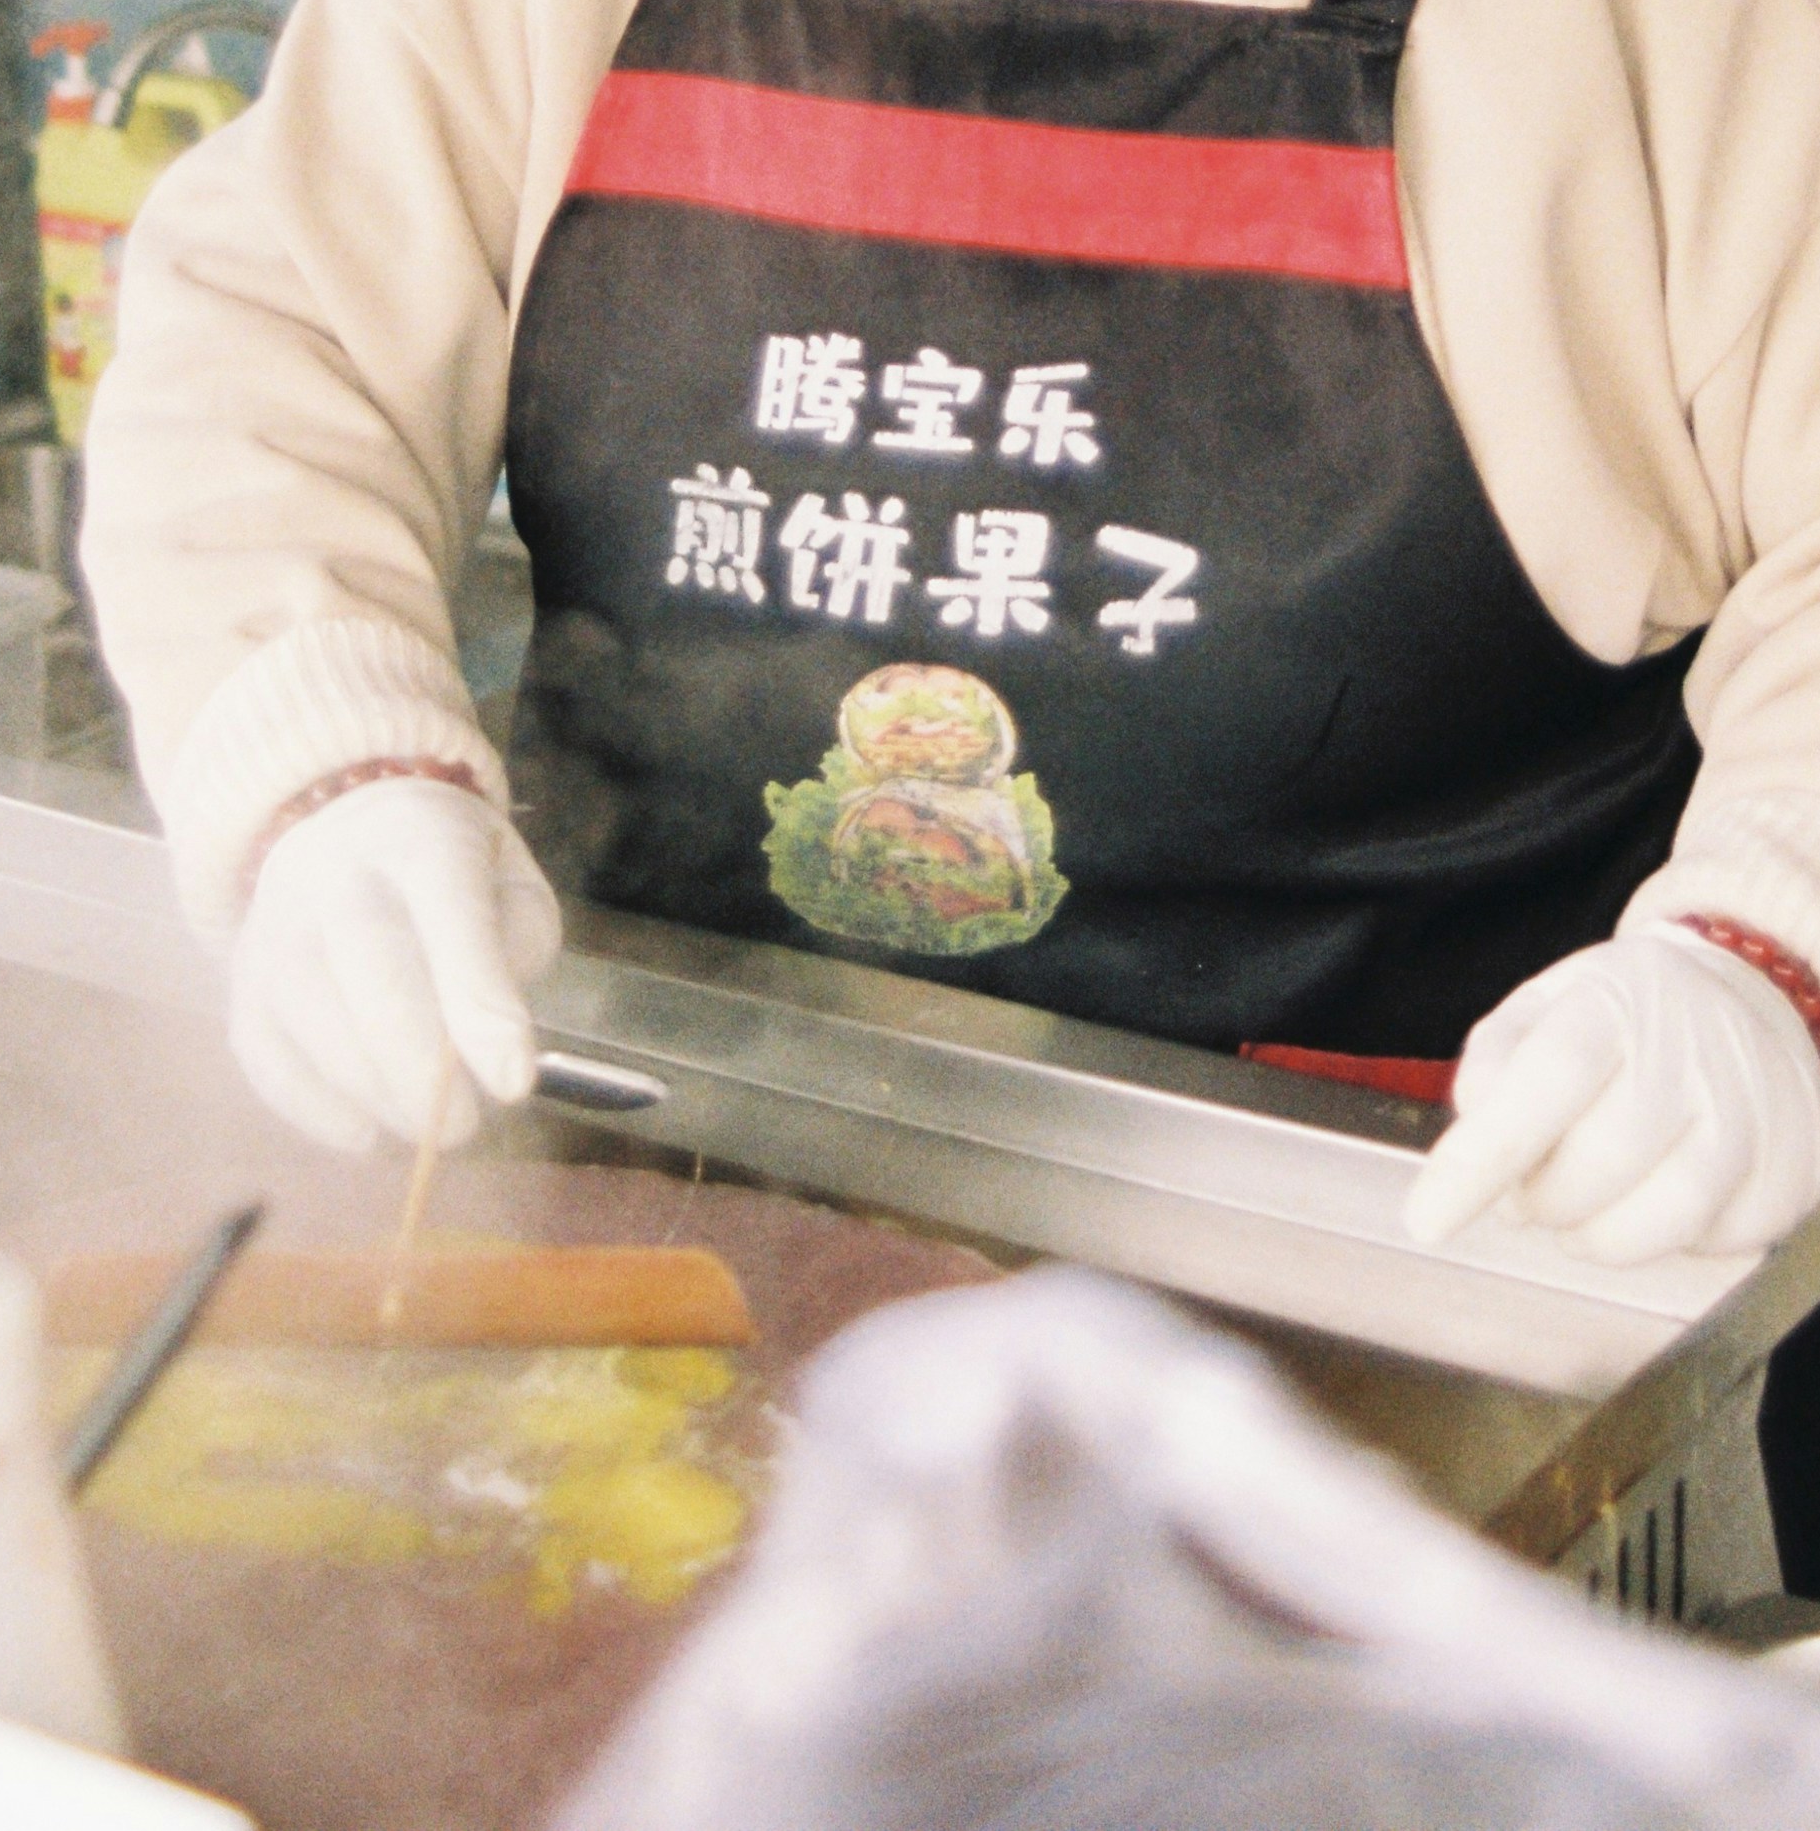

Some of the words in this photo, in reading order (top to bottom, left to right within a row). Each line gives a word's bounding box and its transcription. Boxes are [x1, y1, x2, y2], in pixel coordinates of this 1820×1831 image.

[755, 331, 1103, 467] 腾宝乐
[664, 461, 1202, 656] 煎饼果子
